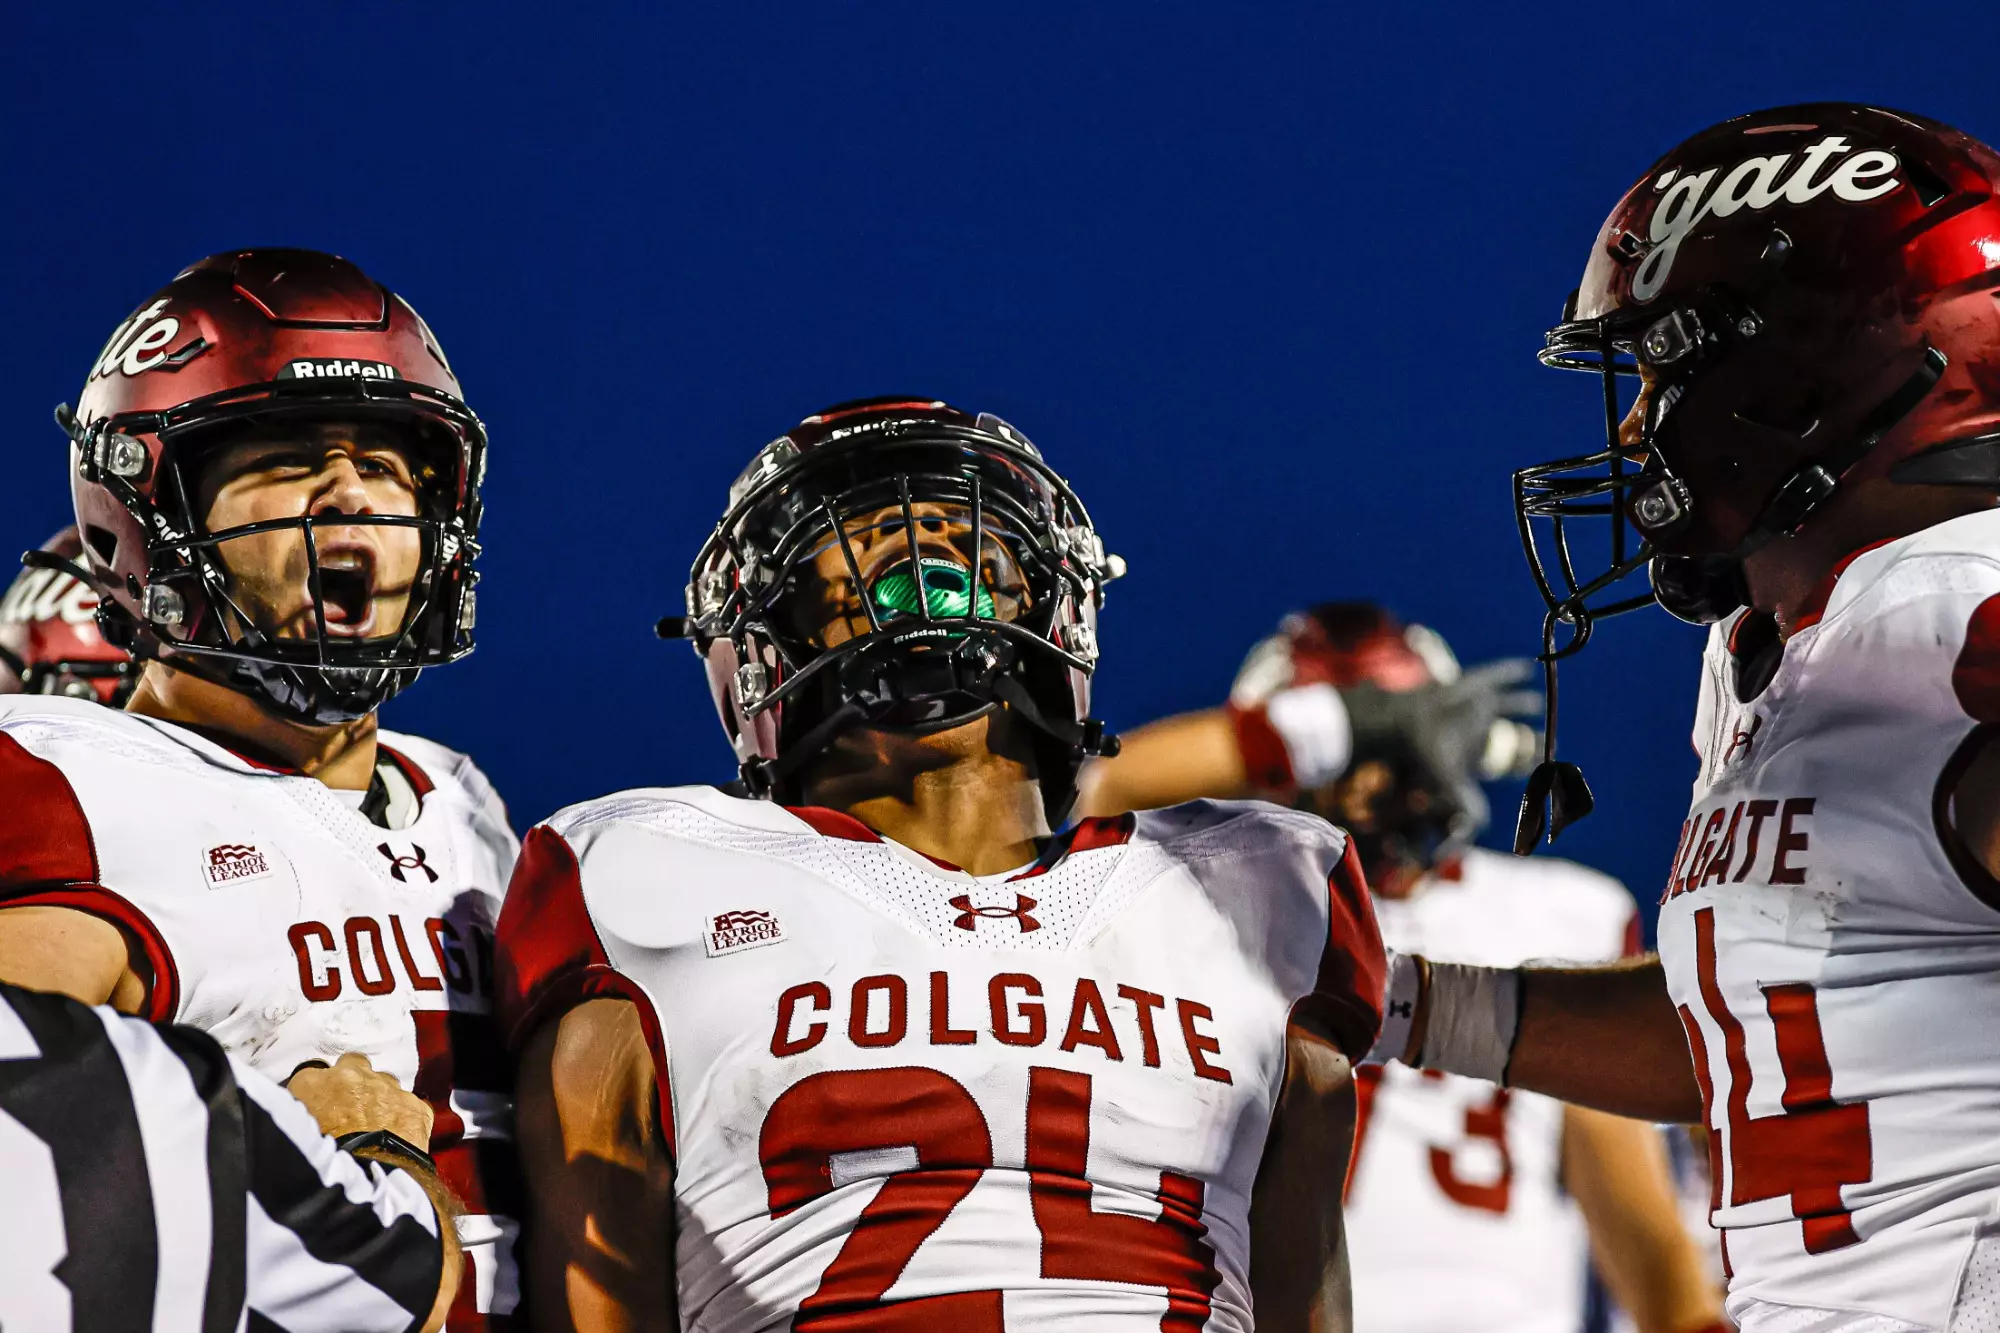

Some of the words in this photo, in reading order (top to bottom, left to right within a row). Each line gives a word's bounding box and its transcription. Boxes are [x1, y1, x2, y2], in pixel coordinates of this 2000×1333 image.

[292, 360, 394, 379] Riddell
[208, 852, 267, 876] PATRIOT
[211, 863, 270, 883] LEAGUE
[711, 918, 780, 943] PATRIOT
[713, 928, 782, 951] LEAGUE
[769, 970, 1234, 1086] COLGATE
[758, 1064, 1223, 1333] 24
